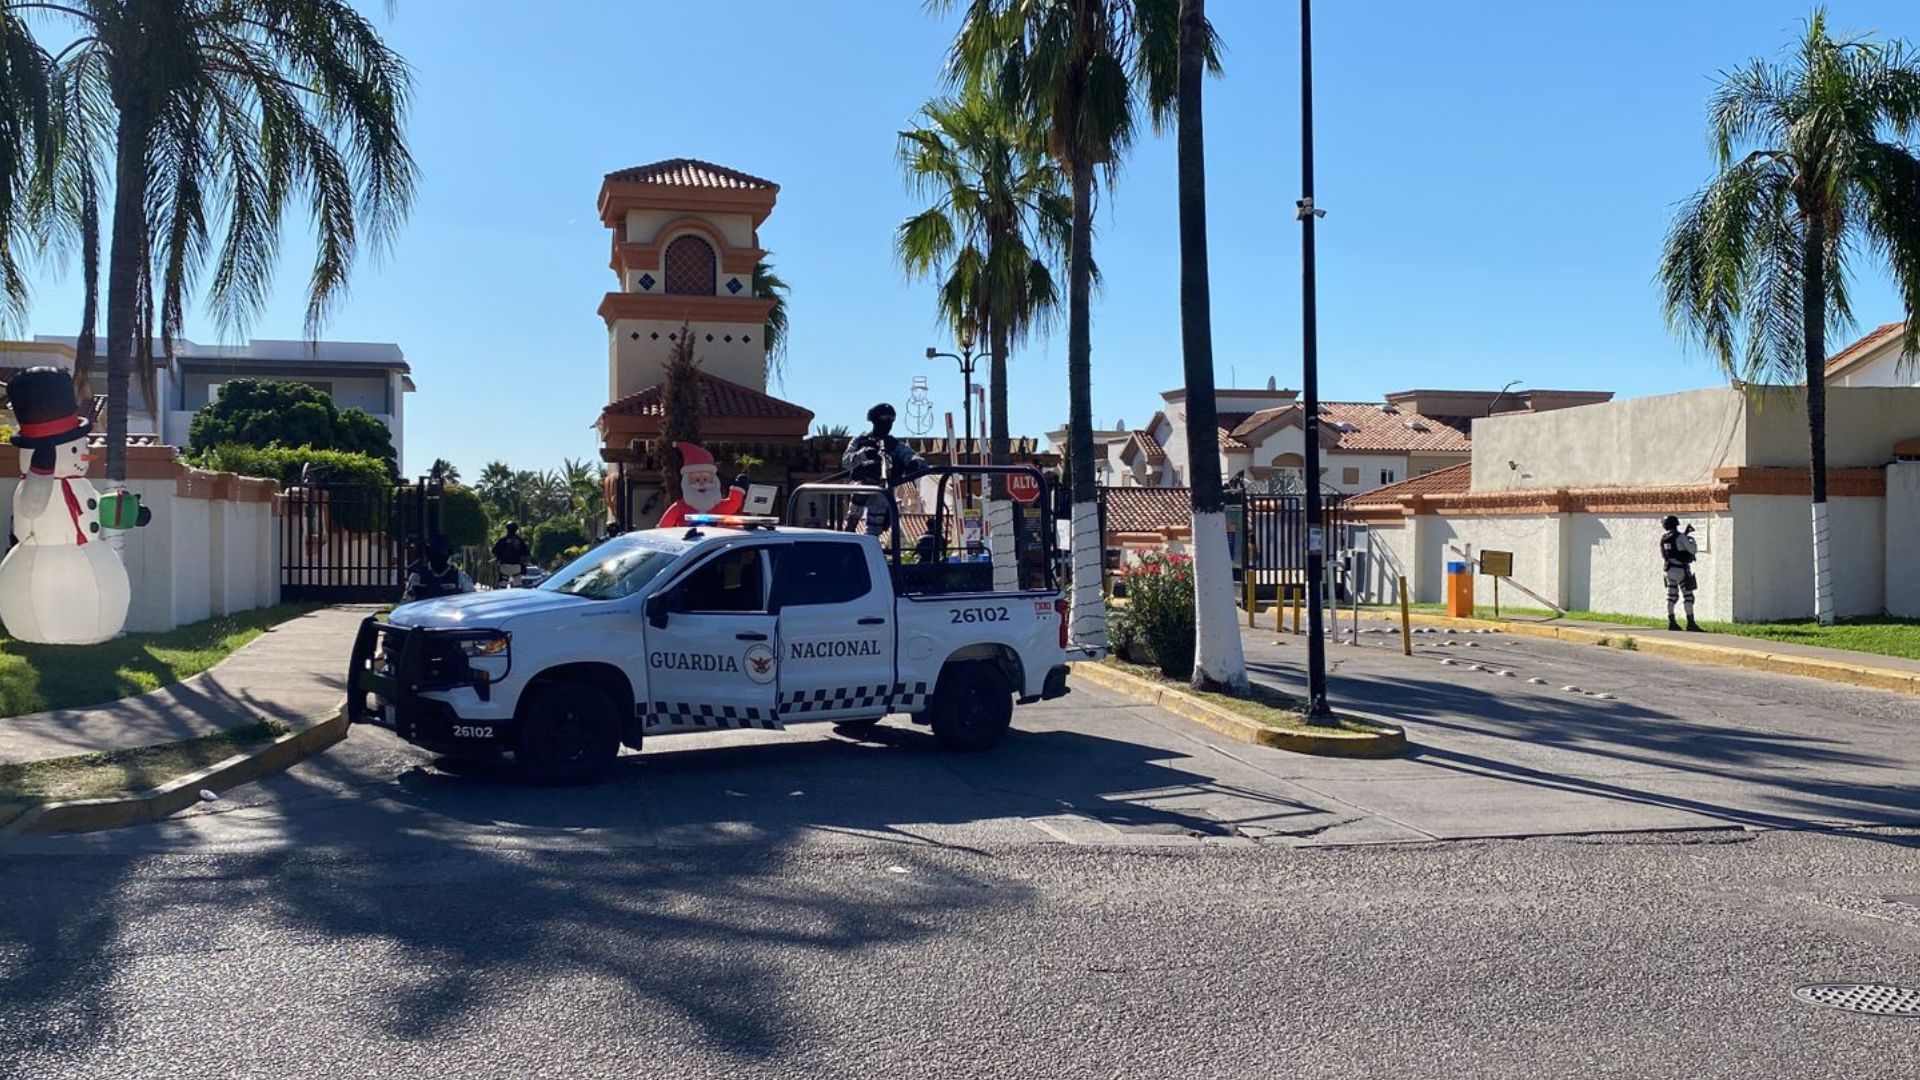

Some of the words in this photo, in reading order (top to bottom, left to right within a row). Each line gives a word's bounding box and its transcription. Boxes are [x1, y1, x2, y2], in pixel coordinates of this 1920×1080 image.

[949, 606, 1010, 624] 26102
[649, 651, 739, 673] GUARDIA
[791, 640, 881, 659] NACIONAL
[452, 725, 494, 738] 26102
